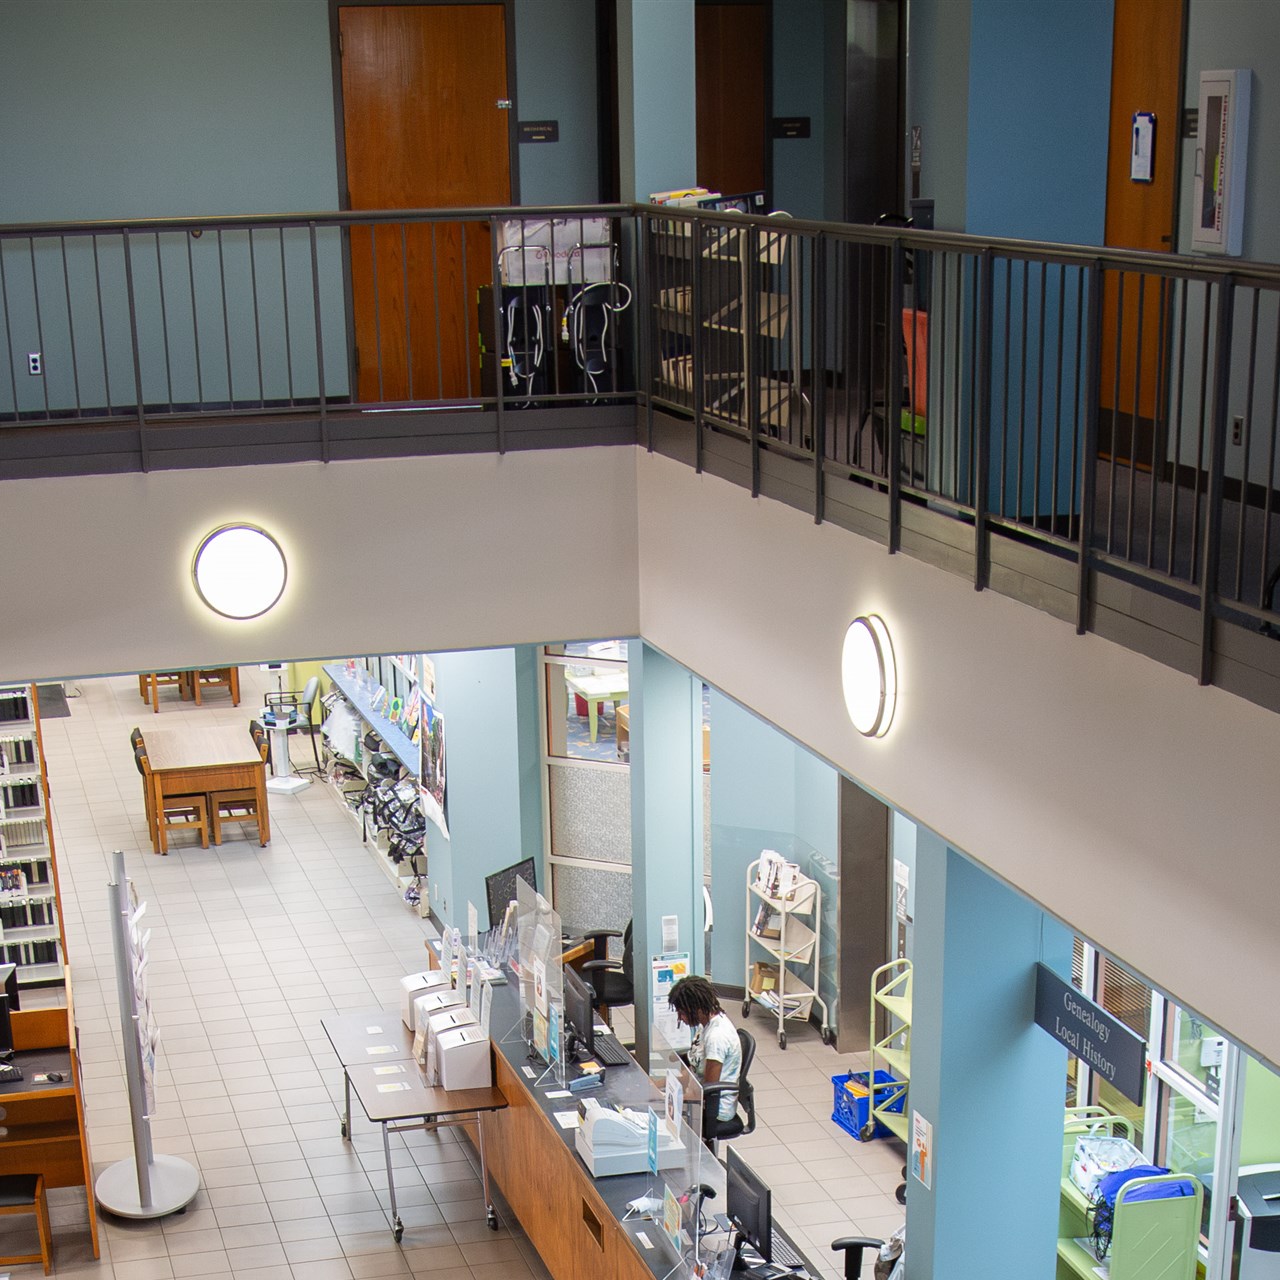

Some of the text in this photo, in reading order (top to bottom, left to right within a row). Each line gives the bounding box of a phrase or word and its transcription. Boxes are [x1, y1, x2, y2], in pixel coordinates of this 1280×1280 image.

[1063, 991, 1111, 1043] Genealogy
[1055, 1016, 1116, 1081] Local History
